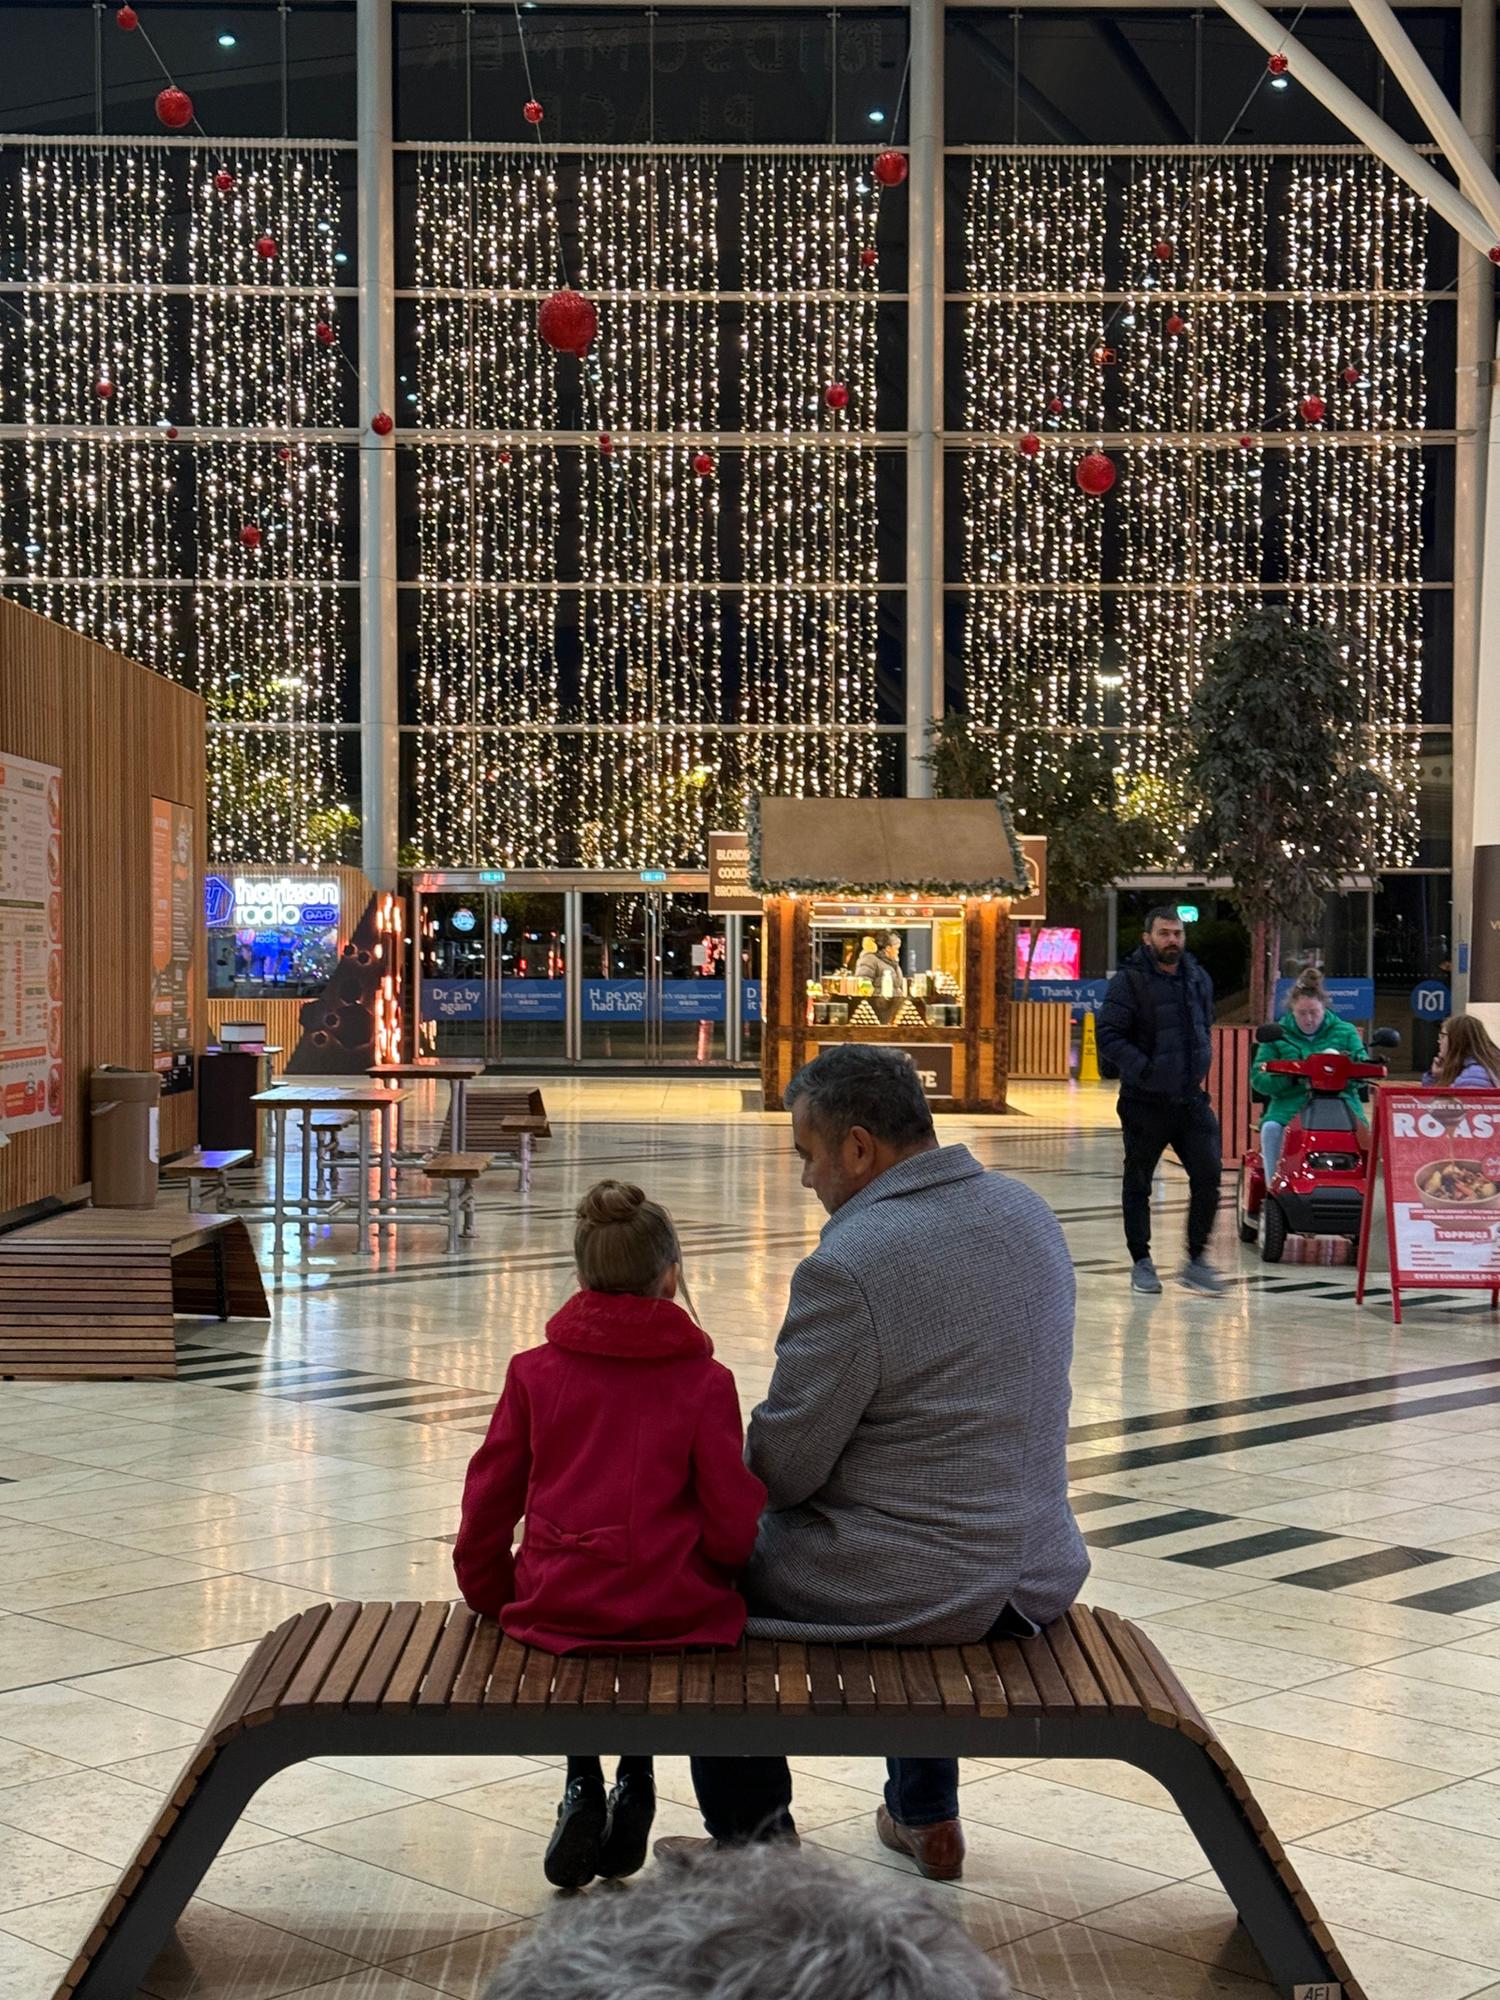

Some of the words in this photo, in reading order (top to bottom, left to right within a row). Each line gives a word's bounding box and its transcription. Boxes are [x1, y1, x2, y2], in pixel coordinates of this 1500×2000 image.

[234, 878, 338, 905] horizon
[236, 902, 301, 925] radio
[432, 988, 462, 1004] Drp
[465, 988, 480, 1003] by
[589, 988, 622, 1004] Hpe
[1040, 986, 1072, 998] Thank
[439, 1001, 472, 1014] again
[591, 999, 614, 1011] had
[617, 1000, 643, 1011] fun?
[1437, 1231, 1489, 1239] TOPPINGS
